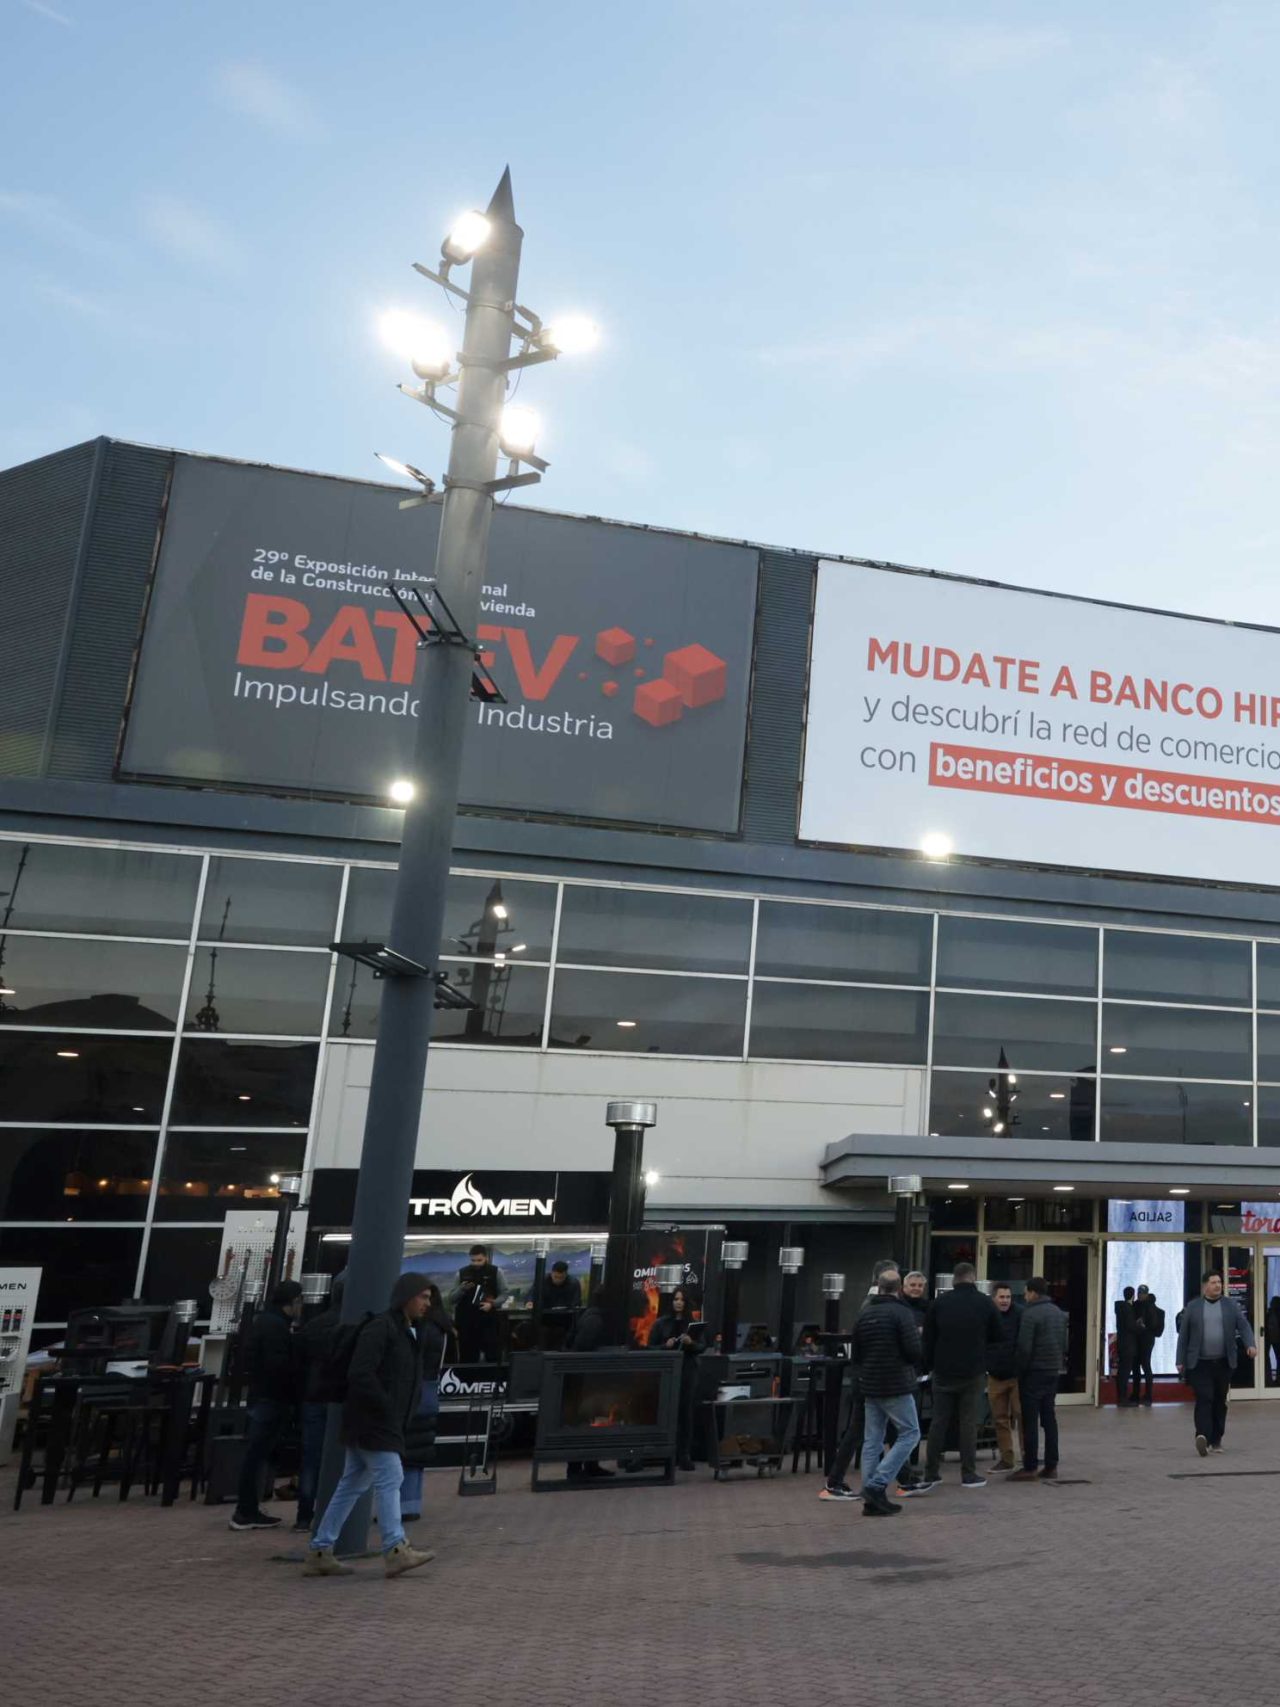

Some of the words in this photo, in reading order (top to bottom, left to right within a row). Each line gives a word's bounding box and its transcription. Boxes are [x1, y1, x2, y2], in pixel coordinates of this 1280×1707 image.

[251, 567, 274, 581] de
[280, 570, 296, 584] la
[294, 554, 388, 580] Exposición
[867, 637, 1040, 694] MUDATE
[1050, 665, 1078, 700] A
[1090, 670, 1223, 720] BANCO
[478, 701, 614, 740] Industria
[863, 696, 881, 723] y
[891, 695, 1021, 737] descubrí
[1030, 712, 1052, 741] la
[1062, 722, 1107, 748] red
[1117, 725, 1151, 753] de
[860, 746, 916, 773] con
[936, 748, 1093, 794] beneficios
[1101, 774, 1117, 800] y
